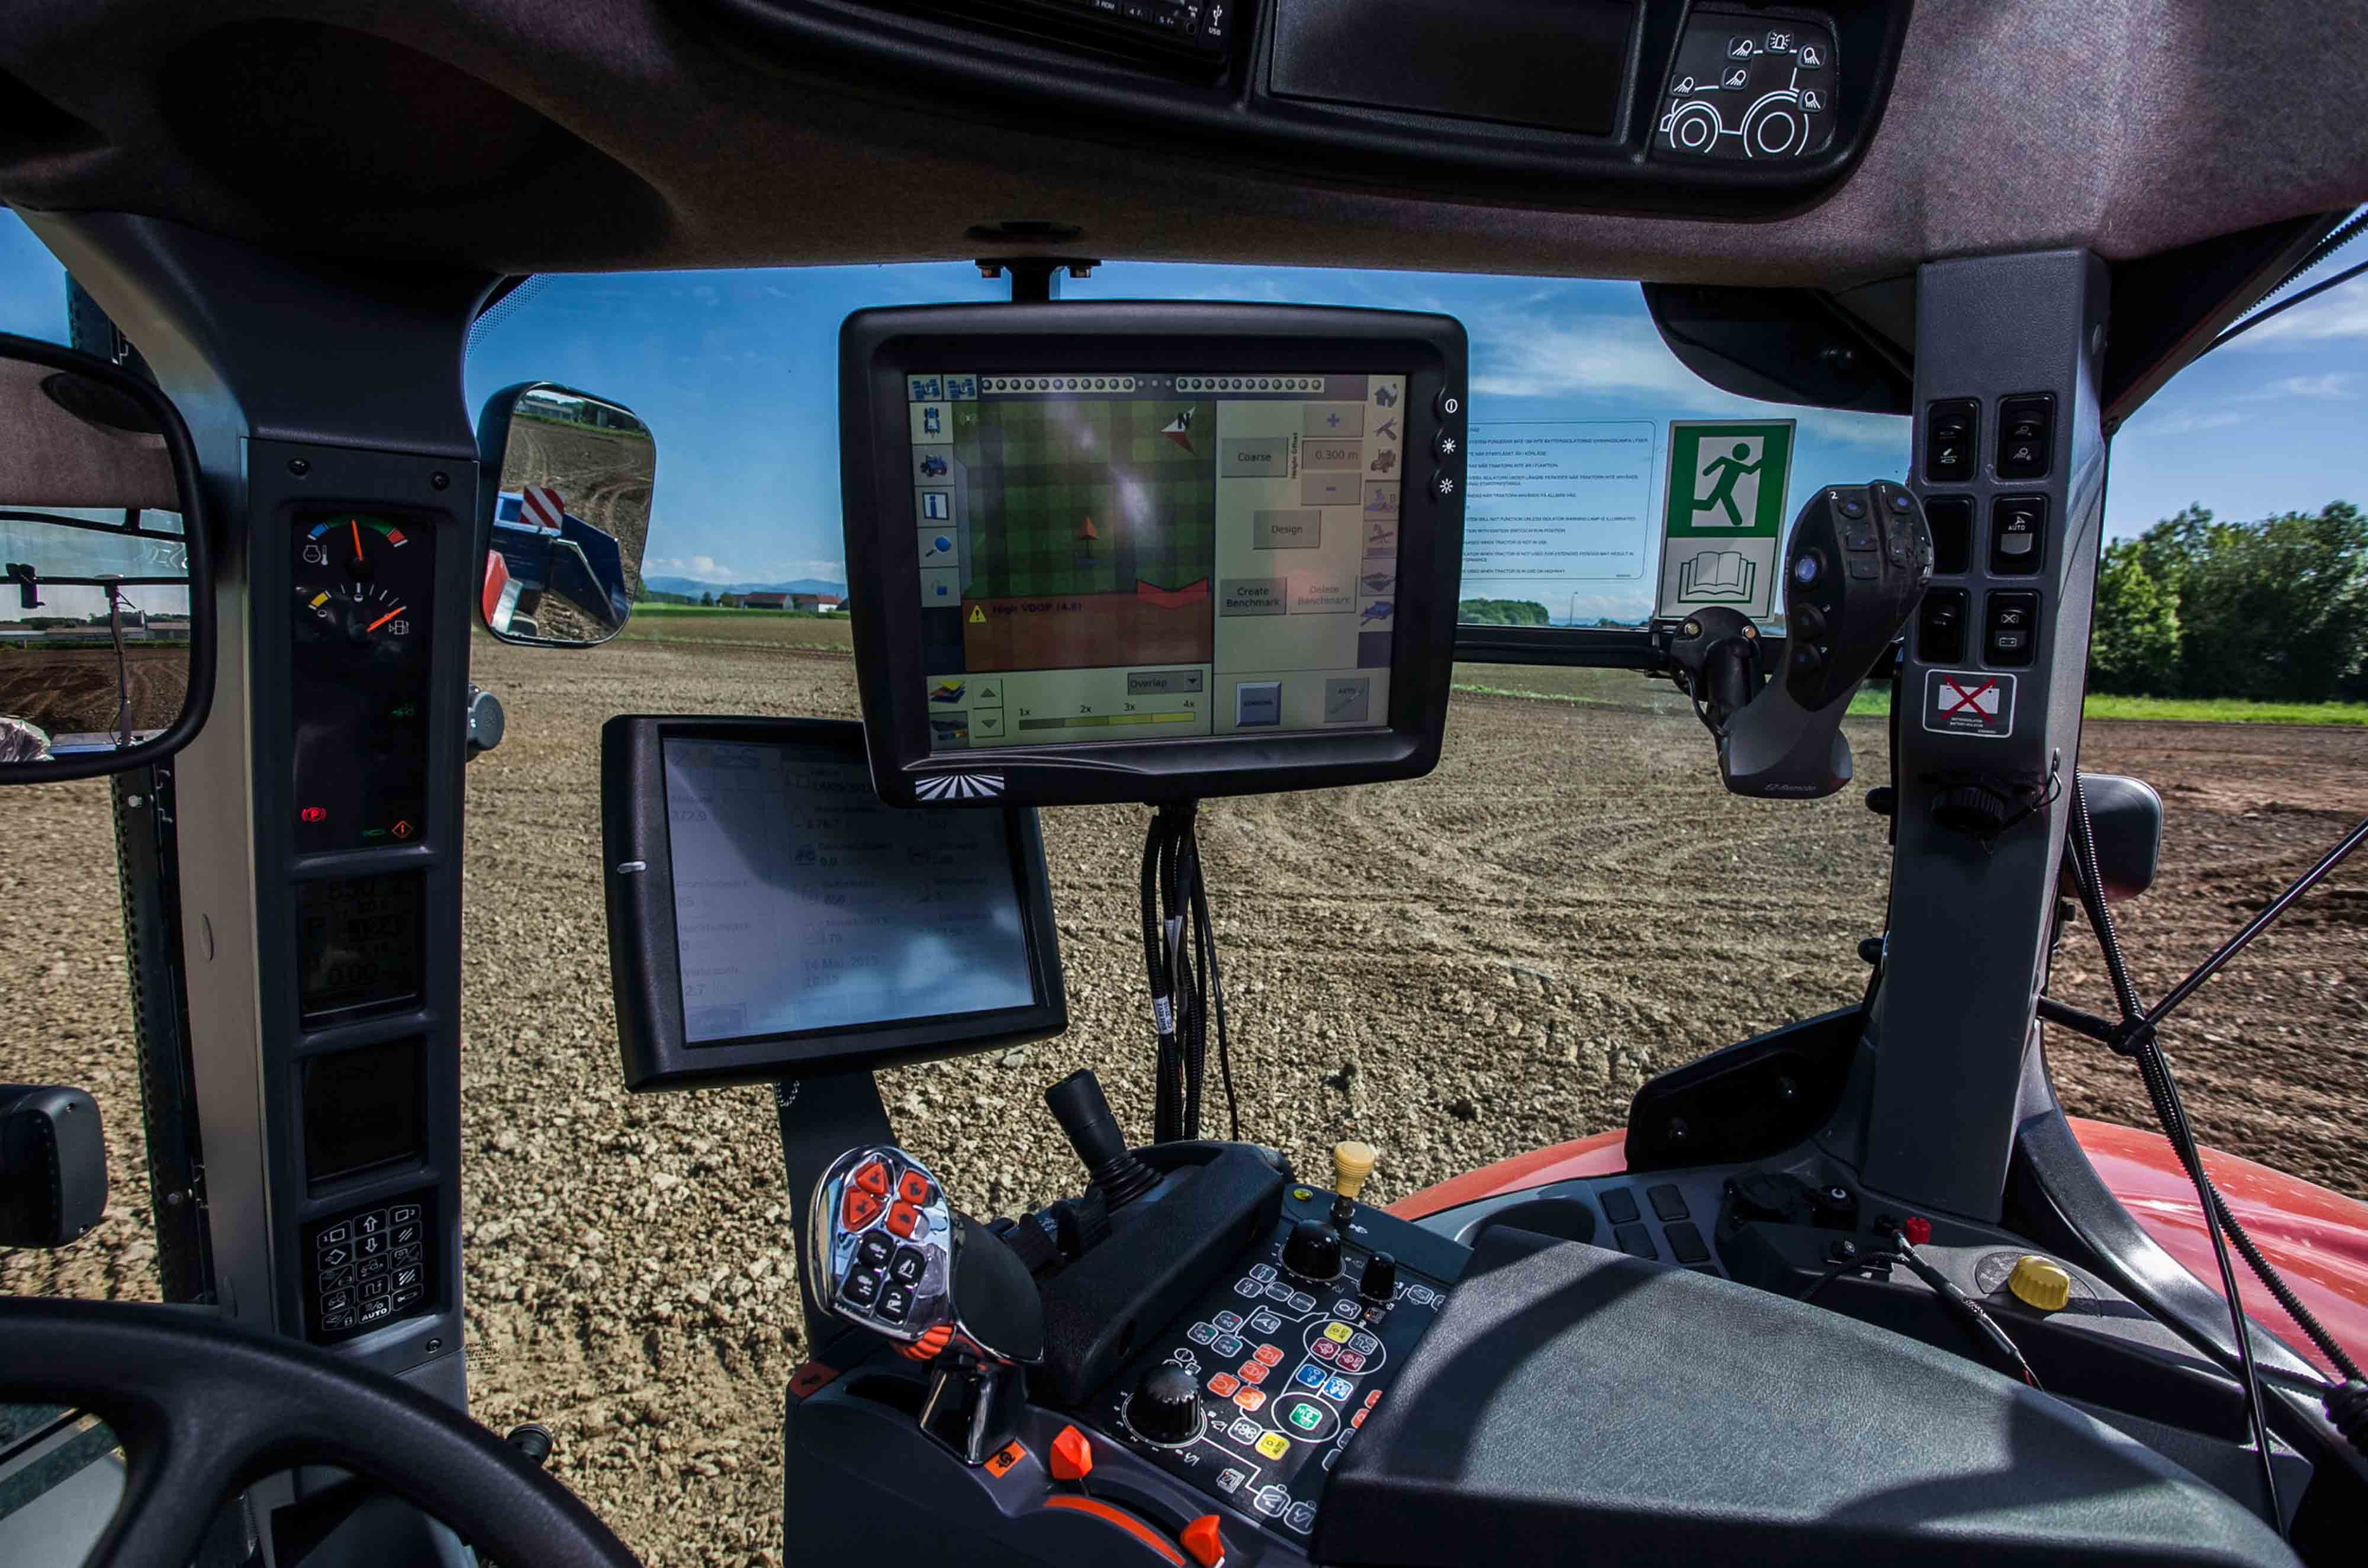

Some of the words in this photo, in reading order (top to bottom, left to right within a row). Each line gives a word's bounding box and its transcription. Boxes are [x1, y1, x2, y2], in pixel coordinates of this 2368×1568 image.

[1208, 27, 1221, 36] USB
[1177, 412, 1190, 430] N
[1237, 452, 1272, 462] Coarse
[1315, 450, 1345, 460] 0.300
[1347, 451, 1359, 460] m
[1830, 491, 1838, 500] 2
[1270, 525, 1304, 535] Design
[1237, 586, 1270, 597] Create
[1310, 584, 1340, 594] Delete
[1226, 596, 1280, 607] Benchmark
[1298, 595, 1351, 606] Benchmark
[1131, 677, 1167, 689] Overlap
[1080, 704, 1092, 713] 2x
[1124, 702, 1136, 711] 3x
[1183, 700, 1195, 708] 4x
[1019, 707, 1031, 717] 1x
[361, 1308, 388, 1322] AUTO
